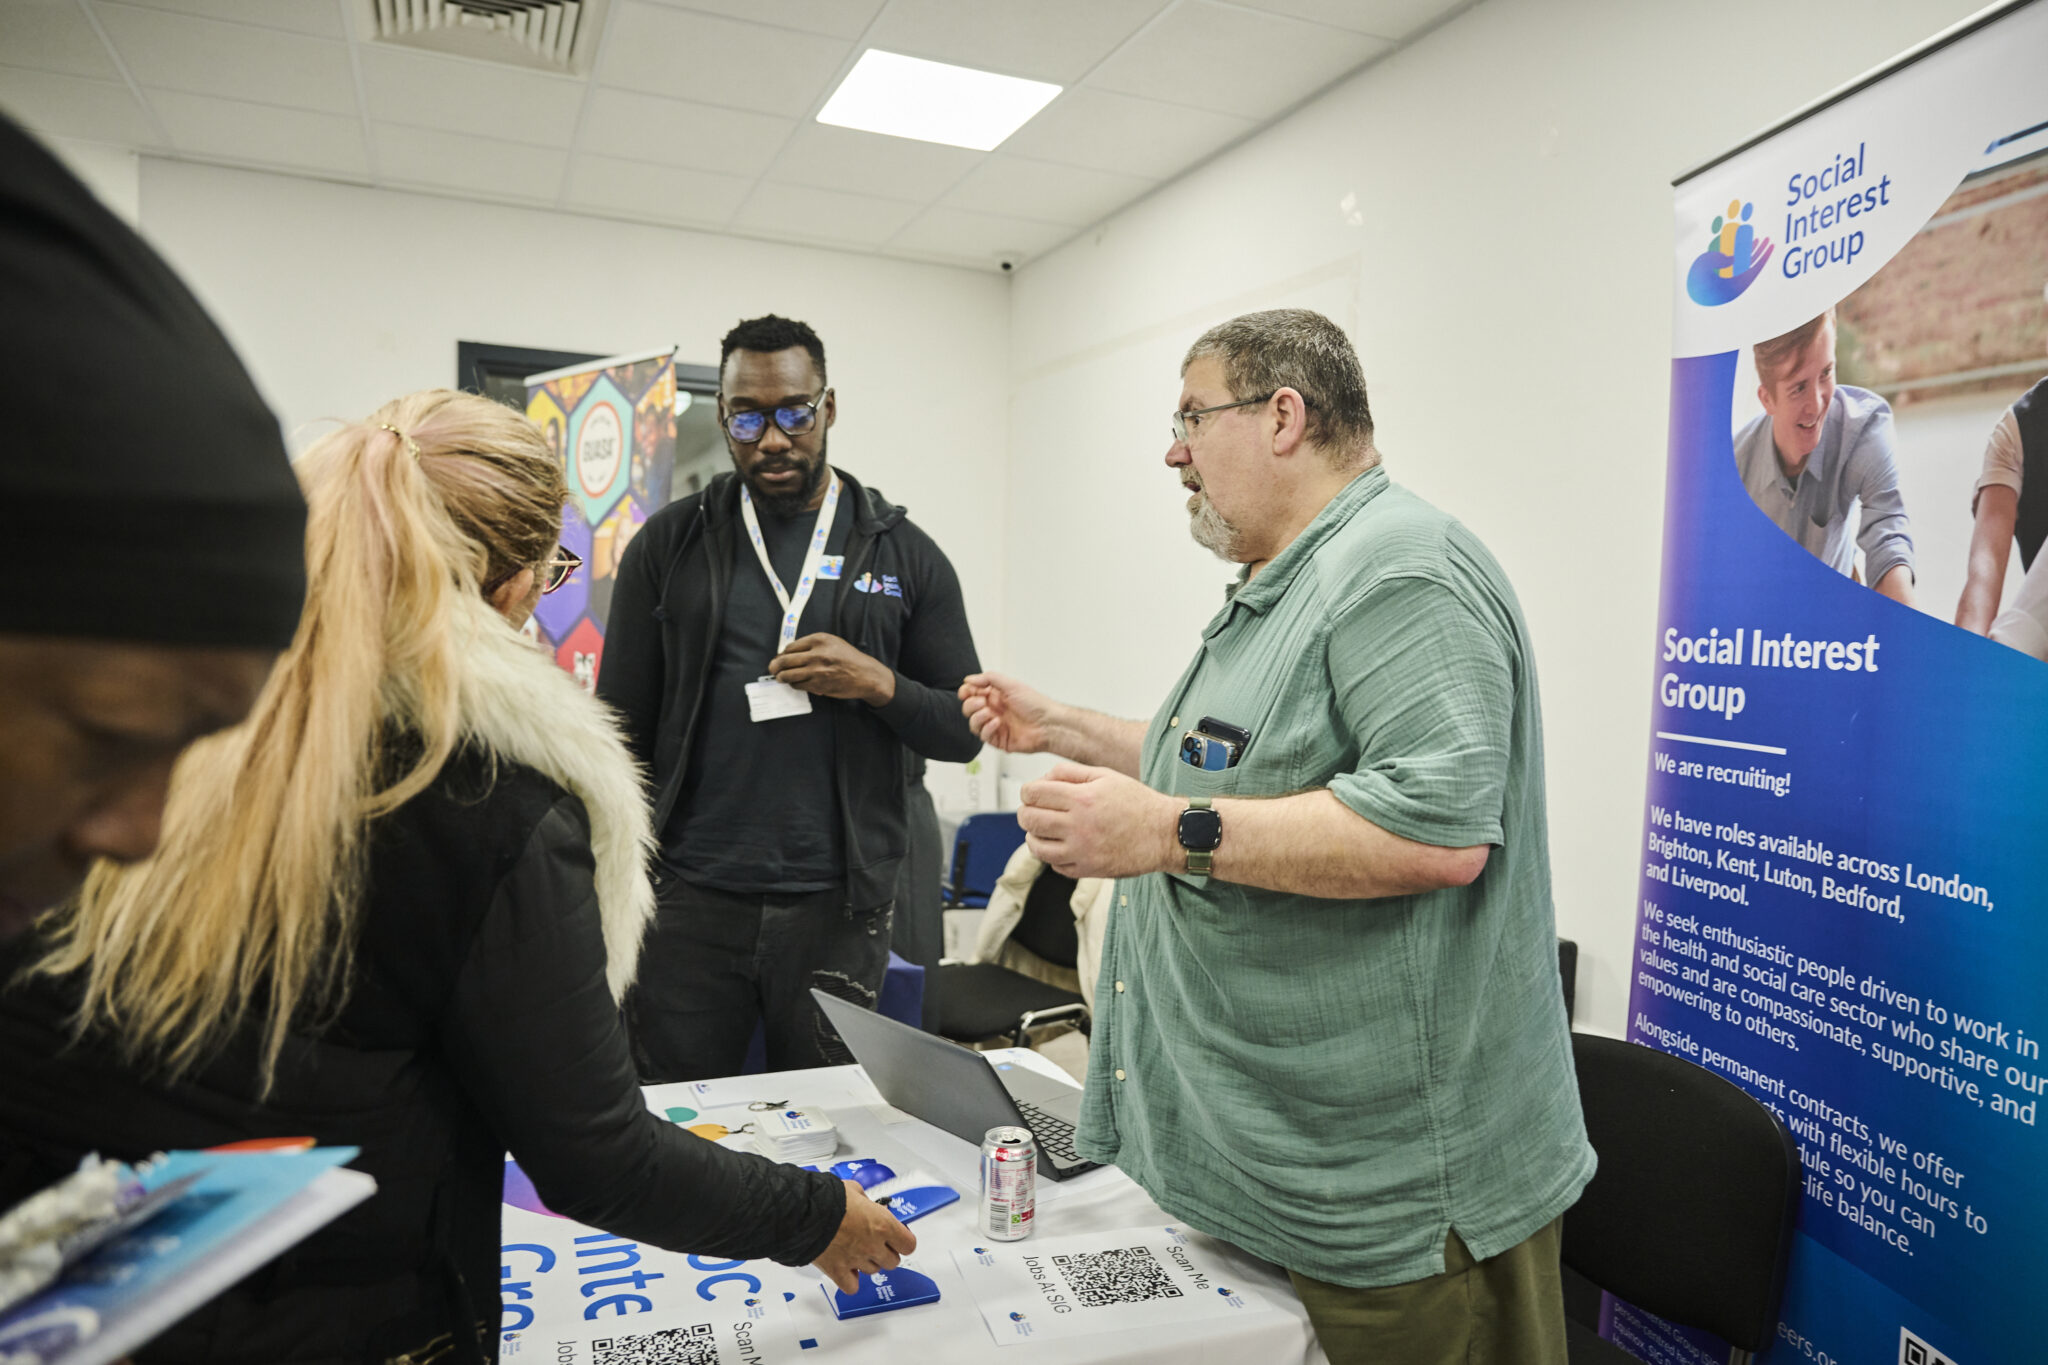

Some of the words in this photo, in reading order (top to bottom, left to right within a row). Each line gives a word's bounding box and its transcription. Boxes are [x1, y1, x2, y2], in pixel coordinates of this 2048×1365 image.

[1785, 174, 1891, 244] Interest
[1788, 142, 1865, 207] Social
[1783, 230, 1864, 279] Group
[1663, 627, 1744, 666] Social
[1751, 629, 1880, 672] Interest
[1660, 673, 1745, 720] Group
[1655, 751, 1675, 774] We
[1678, 760, 1703, 778] are
[1707, 763, 1791, 797] recruiting!
[1646, 861, 1669, 883] and
[1672, 868, 1750, 906] Liverpool.
[1648, 833, 1712, 868] Brighton,
[1716, 849, 1760, 882] Kent,
[1764, 862, 1817, 897] Luton,
[1822, 876, 1905, 922] Bedford,
[1651, 805, 1672, 828] We
[1675, 811, 1712, 836] have
[1715, 821, 1755, 847] roles
[1759, 829, 1833, 866] available
[1838, 853, 1900, 883] across
[1905, 864, 1995, 911] London,
[1638, 970, 1722, 1021] empowering
[1725, 1001, 1743, 1022] to
[1745, 1014, 1800, 1052] others.
[1642, 923, 1660, 946] the
[1663, 930, 1707, 963] health
[1711, 947, 1740, 973] and
[1743, 959, 1786, 992] social
[1790, 981, 1825, 1007] care
[1830, 995, 1887, 1031] sector
[1891, 1015, 1935, 1051] who
[1940, 1037, 1999, 1077] share
[2005, 1066, 2048, 1095] our
[1644, 900, 1663, 924] We
[1666, 910, 1699, 936] seek
[1703, 924, 1794, 968] enthusiastic
[1798, 956, 1856, 992] people
[1860, 975, 1920, 1015] driven
[1926, 999, 1948, 1025] to
[1953, 1011, 2010, 1050] work
[2016, 1029, 2039, 1060] in
[1640, 946, 1678, 975] values
[1682, 961, 1709, 988] and
[1713, 976, 1737, 998] are
[1741, 986, 1867, 1055] compassionate,
[1871, 1043, 1984, 1108] supportive,
[1990, 1093, 2036, 1126] and
[1634, 1012, 1699, 1056] Alongside
[1702, 1047, 1786, 1099] permanent
[1789, 1089, 1873, 1146] contracts,
[1878, 1132, 1908, 1160] we
[1912, 1150, 1965, 1189] offer
[1788, 1115, 1825, 1147] with
[1830, 1132, 1896, 1184] flexible
[1901, 1169, 1958, 1219] hours
[1964, 1203, 1989, 1235] to
[1796, 1143, 1831, 1177] dule
[1834, 1168, 1855, 1191] so
[1860, 1181, 1895, 1215] you
[1900, 1211, 1936, 1239] can
[1801, 1174, 1833, 1207] -life
[1838, 1192, 1914, 1257] balance.
[500, 1243, 556, 1332] Gro
[574, 1232, 665, 1320] Inte
[1022, 1256, 1046, 1280] Jobs
[1037, 1282, 1057, 1293] At
[1047, 1295, 1072, 1314] SIG
[1166, 1246, 1195, 1271] Scan
[1188, 1273, 1210, 1290] Me
[733, 1321, 755, 1355] Scan
